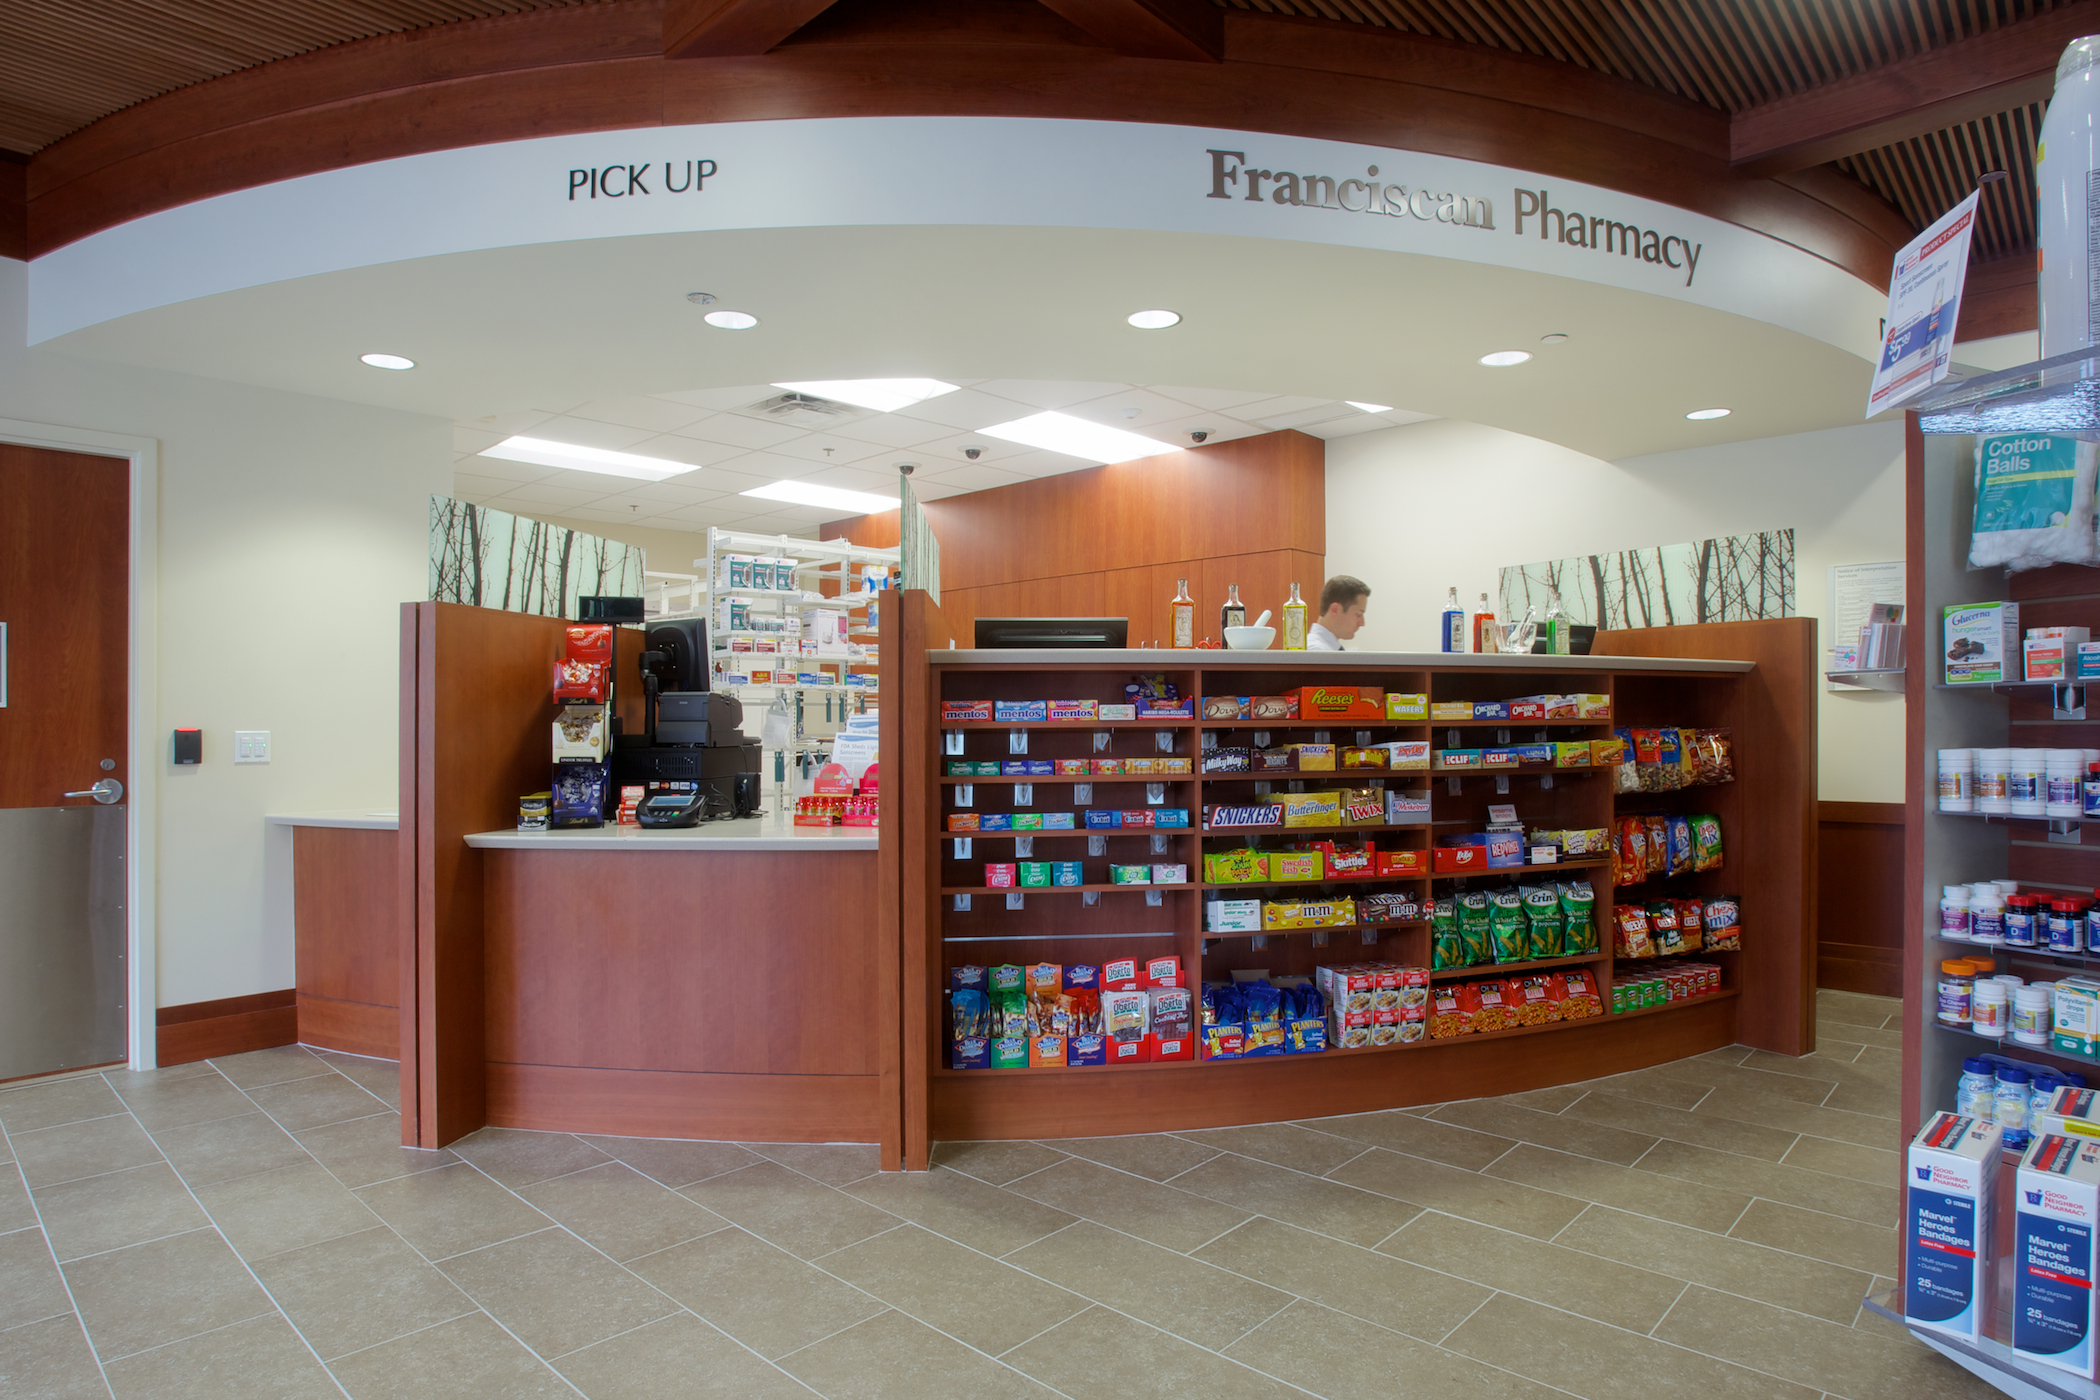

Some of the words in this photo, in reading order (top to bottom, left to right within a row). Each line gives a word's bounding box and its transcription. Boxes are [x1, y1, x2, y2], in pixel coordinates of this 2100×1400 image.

[568, 163, 651, 201] PICK
[665, 159, 718, 193] UP
[1205, 148, 1496, 231] Franciscan
[1513, 187, 1703, 288] Pharmacy
[1948, 214, 1971, 241] SPECIAL
[1987, 437, 2052, 458] Cotton
[1986, 455, 2031, 475] Balls
[1951, 610, 1991, 626] Glucerna
[1951, 626, 1977, 634] hunger
[945, 710, 988, 719] mentos
[1000, 708, 1042, 718] mentos
[1052, 708, 1093, 718] mentos
[1393, 705, 1424, 713] WAFERS
[1475, 704, 1501, 715] ORCHARD
[1512, 704, 1537, 715] ORCHARD
[1300, 746, 1328, 754] SNICKERS
[1206, 757, 1226, 770] Milky
[1225, 755, 1242, 767] Way
[1450, 755, 1468, 765] CLIF
[1490, 753, 1508, 763] CLIF
[2017, 784, 2033, 792] Daily
[1287, 801, 1338, 817] Butterfinger
[1399, 802, 1430, 811] Musketeers
[1213, 806, 1281, 825] SNICKERS
[953, 820, 974, 828] Trident
[984, 819, 1006, 827] Trident
[1016, 818, 1038, 826] Trident
[1047, 817, 1068, 826] Trident
[1231, 861, 1251, 870] SOUR
[1281, 858, 1313, 867] Swedish
[1334, 855, 1368, 870] Skittles
[1231, 867, 1252, 876] PATCH
[1281, 865, 1298, 874] Fish
[1704, 902, 1733, 918] Chex
[1709, 912, 1735, 928] mix
[2010, 927, 2018, 936] D
[2051, 932, 2060, 940] D
[1107, 967, 1131, 977] Oberto
[1151, 966, 1172, 976] Oberto
[1526, 989, 1544, 998] MEIN
[1569, 984, 1586, 993] MEIN
[1158, 998, 1183, 1010] Oberto
[1437, 1000, 1456, 1009] MEIN
[1483, 995, 1501, 1003] MEIN
[2057, 995, 2094, 1007] Polyvitamin
[1113, 1000, 1139, 1012] Oberto
[1252, 1021, 1280, 1033] PLANTERS
[1291, 1020, 1324, 1032] PLANTERS
[1208, 1026, 1242, 1038] PLANTERS
[1932, 1165, 1954, 1175] GOOD
[1932, 1172, 1969, 1183] NEIGHBOR
[1932, 1177, 1971, 1190] PHARMACY
[2044, 1190, 2068, 1200] GOOD
[1952, 1200, 1971, 1209] STERILE
[2044, 1196, 2084, 1210] NEIGHBOR
[2044, 1202, 2087, 1217] PHARMACY
[1918, 1218, 1956, 1234] Heroes
[1918, 1226, 1970, 1247] Bandages
[2066, 1227, 2088, 1237] STERILE
[2028, 1244, 2070, 1263] Heroes
[1921, 1263, 1942, 1273] Durable
[2028, 1254, 2086, 1277] Bandages
[2030, 1267, 2045, 1276] Latex
[2045, 1271, 2058, 1279] Free
[1917, 1277, 1932, 1288] 25
[1932, 1284, 1964, 1297] bandages
[2031, 1292, 2055, 1304] Durable
[2026, 1307, 2043, 1319] 25
[2042, 1314, 2079, 1330] bandages
